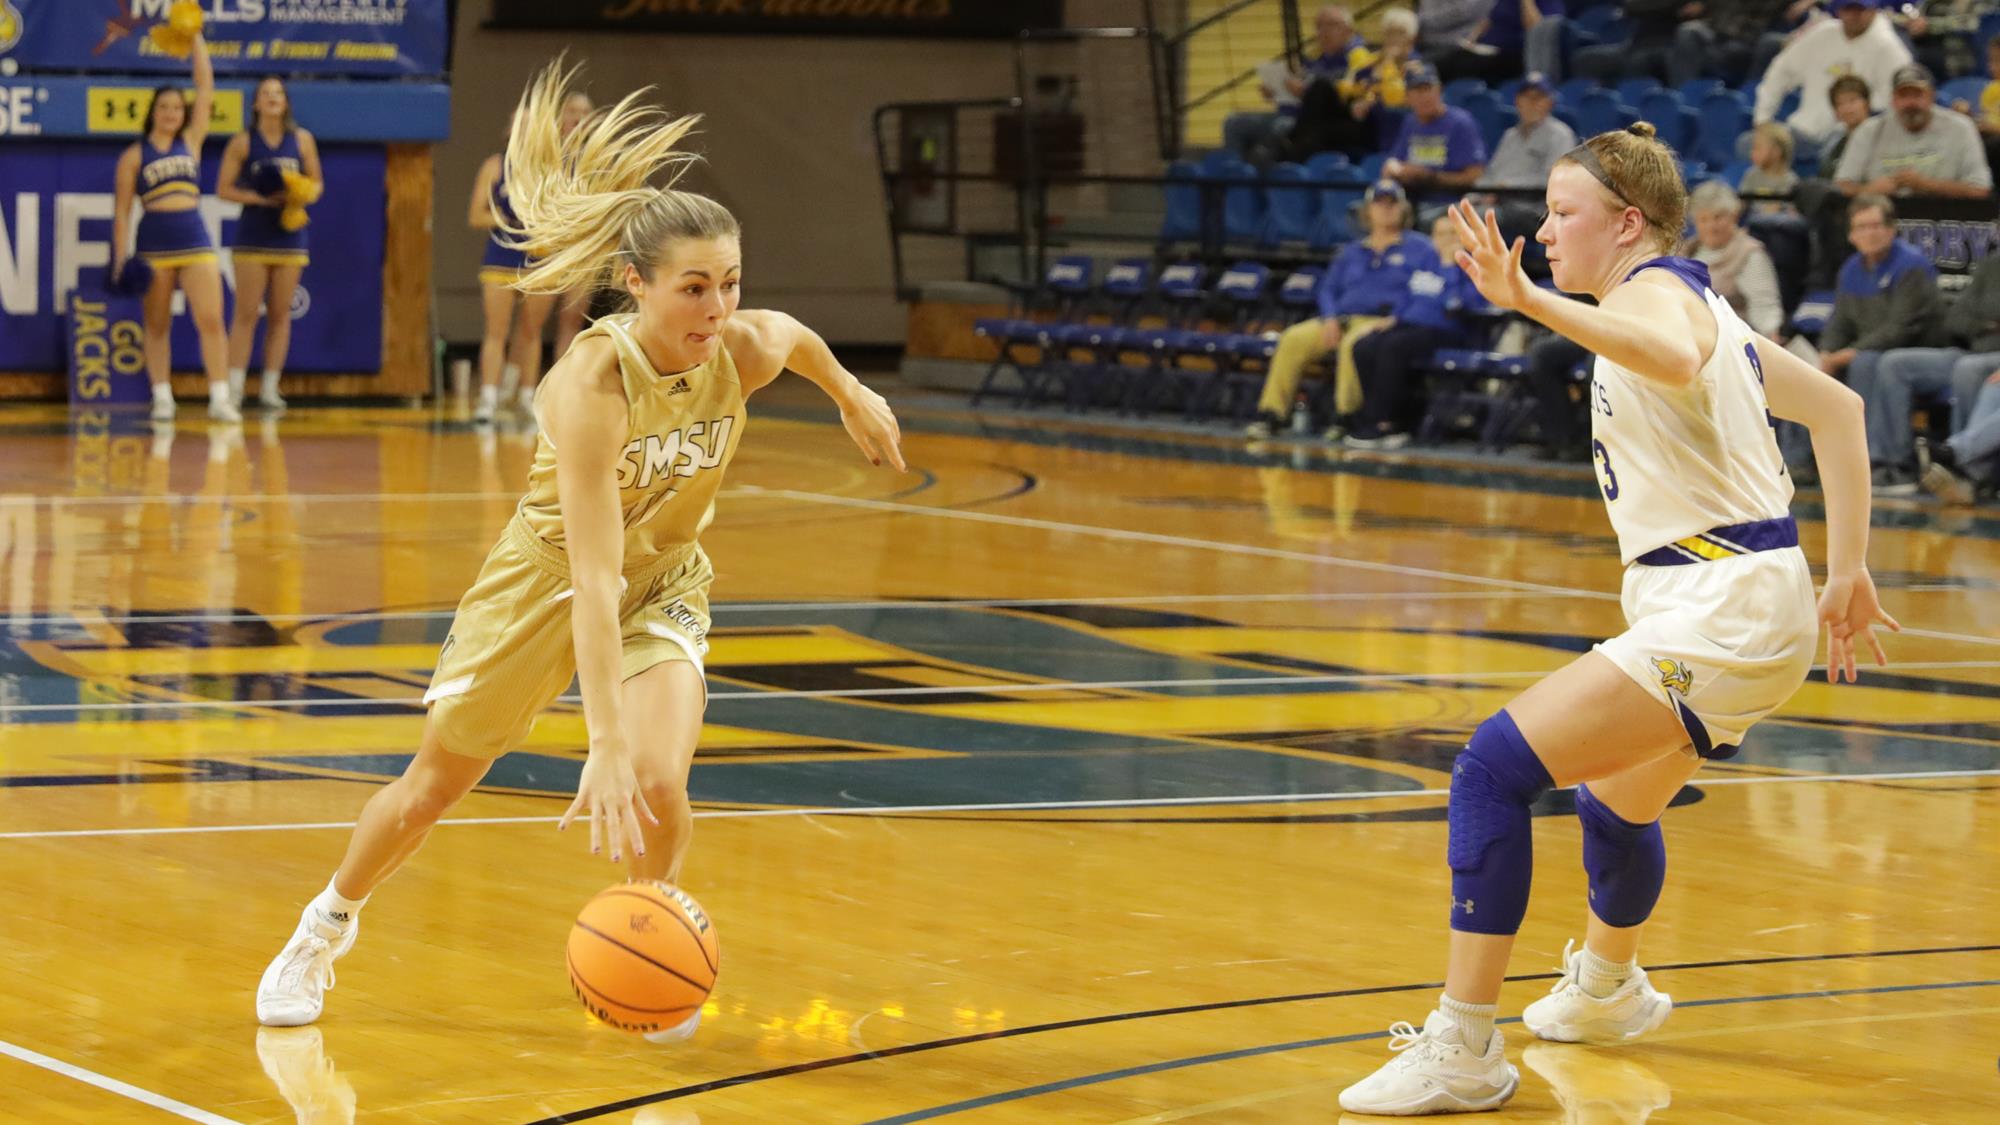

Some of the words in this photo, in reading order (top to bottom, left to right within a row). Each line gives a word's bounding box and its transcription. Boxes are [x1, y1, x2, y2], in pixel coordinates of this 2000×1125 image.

[142, 155, 197, 187] STATE
[73, 297, 112, 399] JACKS
[110, 320, 146, 376] GO
[616, 415, 735, 489] SMSU
